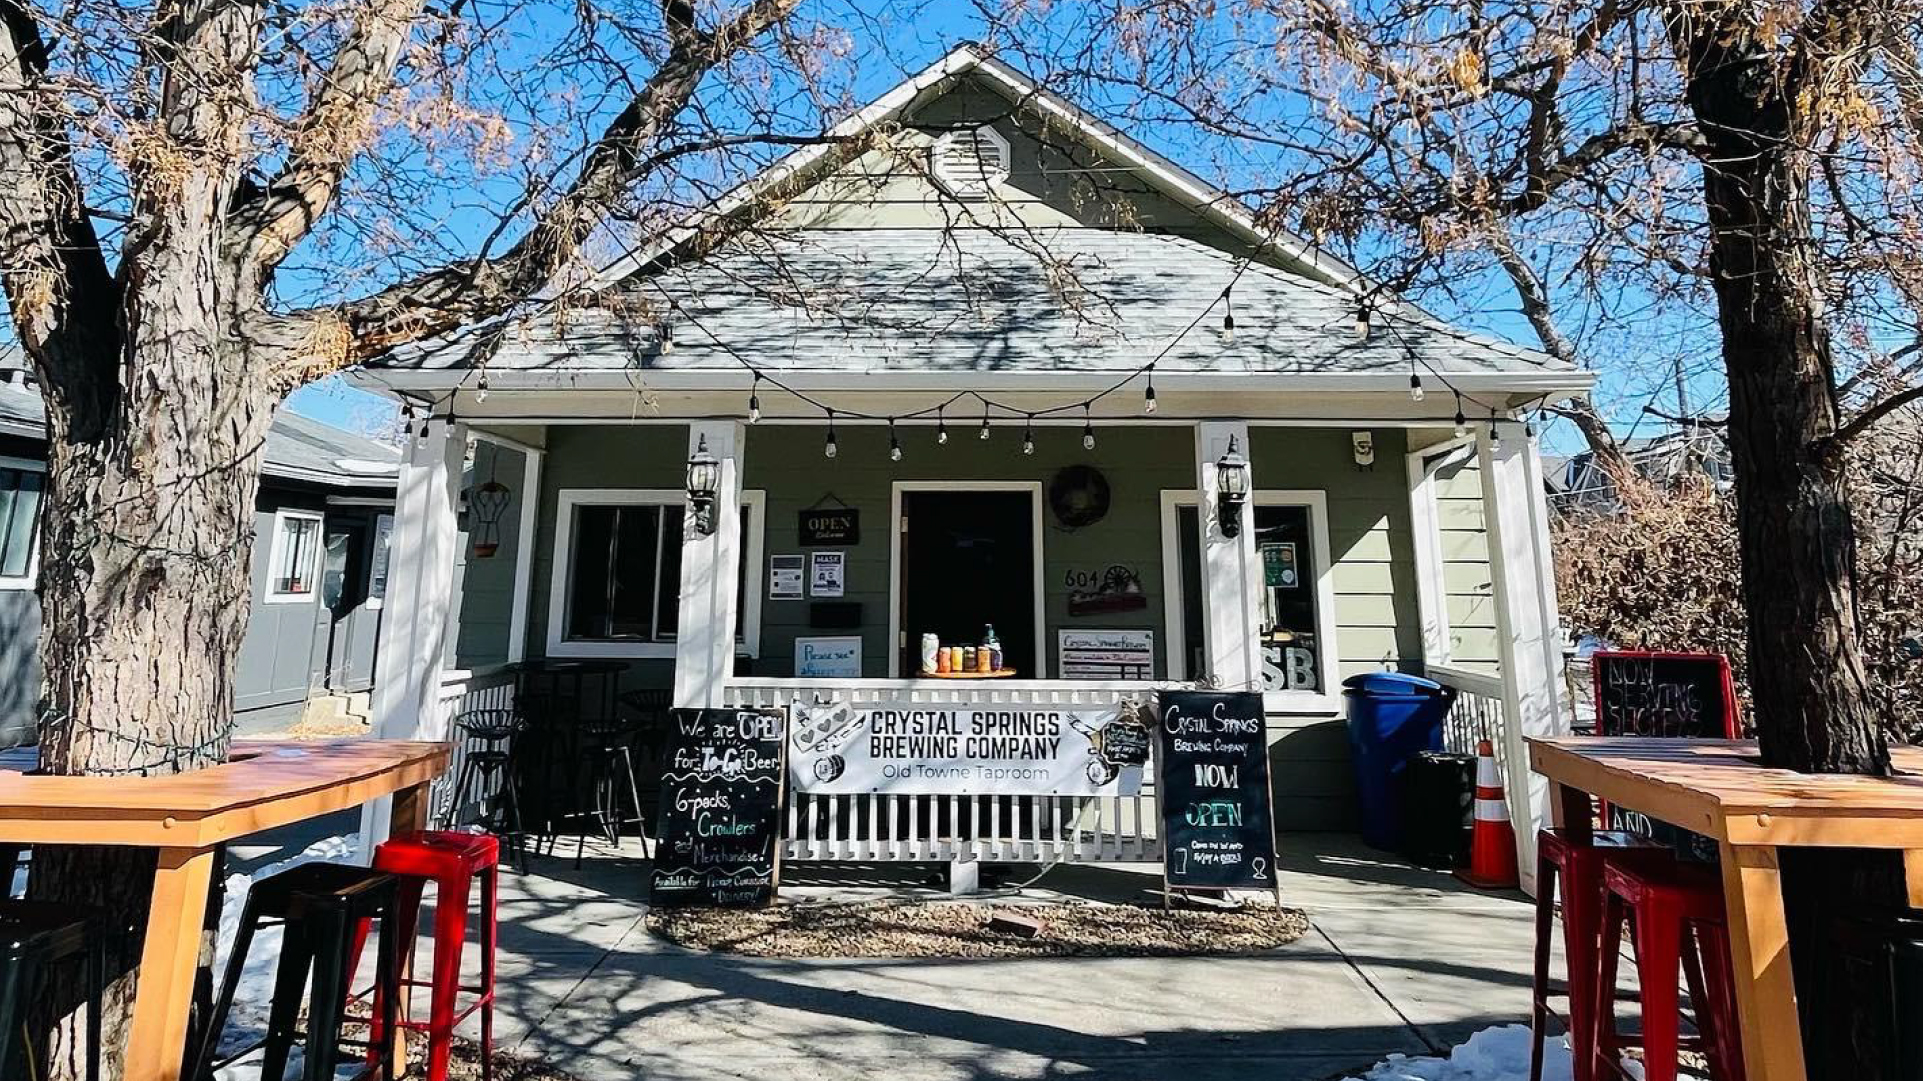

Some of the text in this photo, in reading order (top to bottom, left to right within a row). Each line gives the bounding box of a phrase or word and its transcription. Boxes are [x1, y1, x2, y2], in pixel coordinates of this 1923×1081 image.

[808, 516, 852, 530] OPEN
[1064, 569, 1098, 587] 604
[1260, 647, 1316, 691] SB
[678, 711, 784, 740] We are OPEN
[870, 711, 1060, 736] CRYSTAL SPRINGS
[870, 736, 1060, 761] BREWING COMPANY
[1174, 738, 1212, 752] BREWING
[674, 748, 696, 769] for
[882, 764, 1050, 782] Old Towne Taproom
[1194, 764, 1239, 789] NOW
[697, 811, 756, 838] Crowlers
[1185, 802, 1243, 827] OPEN
[674, 837, 694, 851] and
